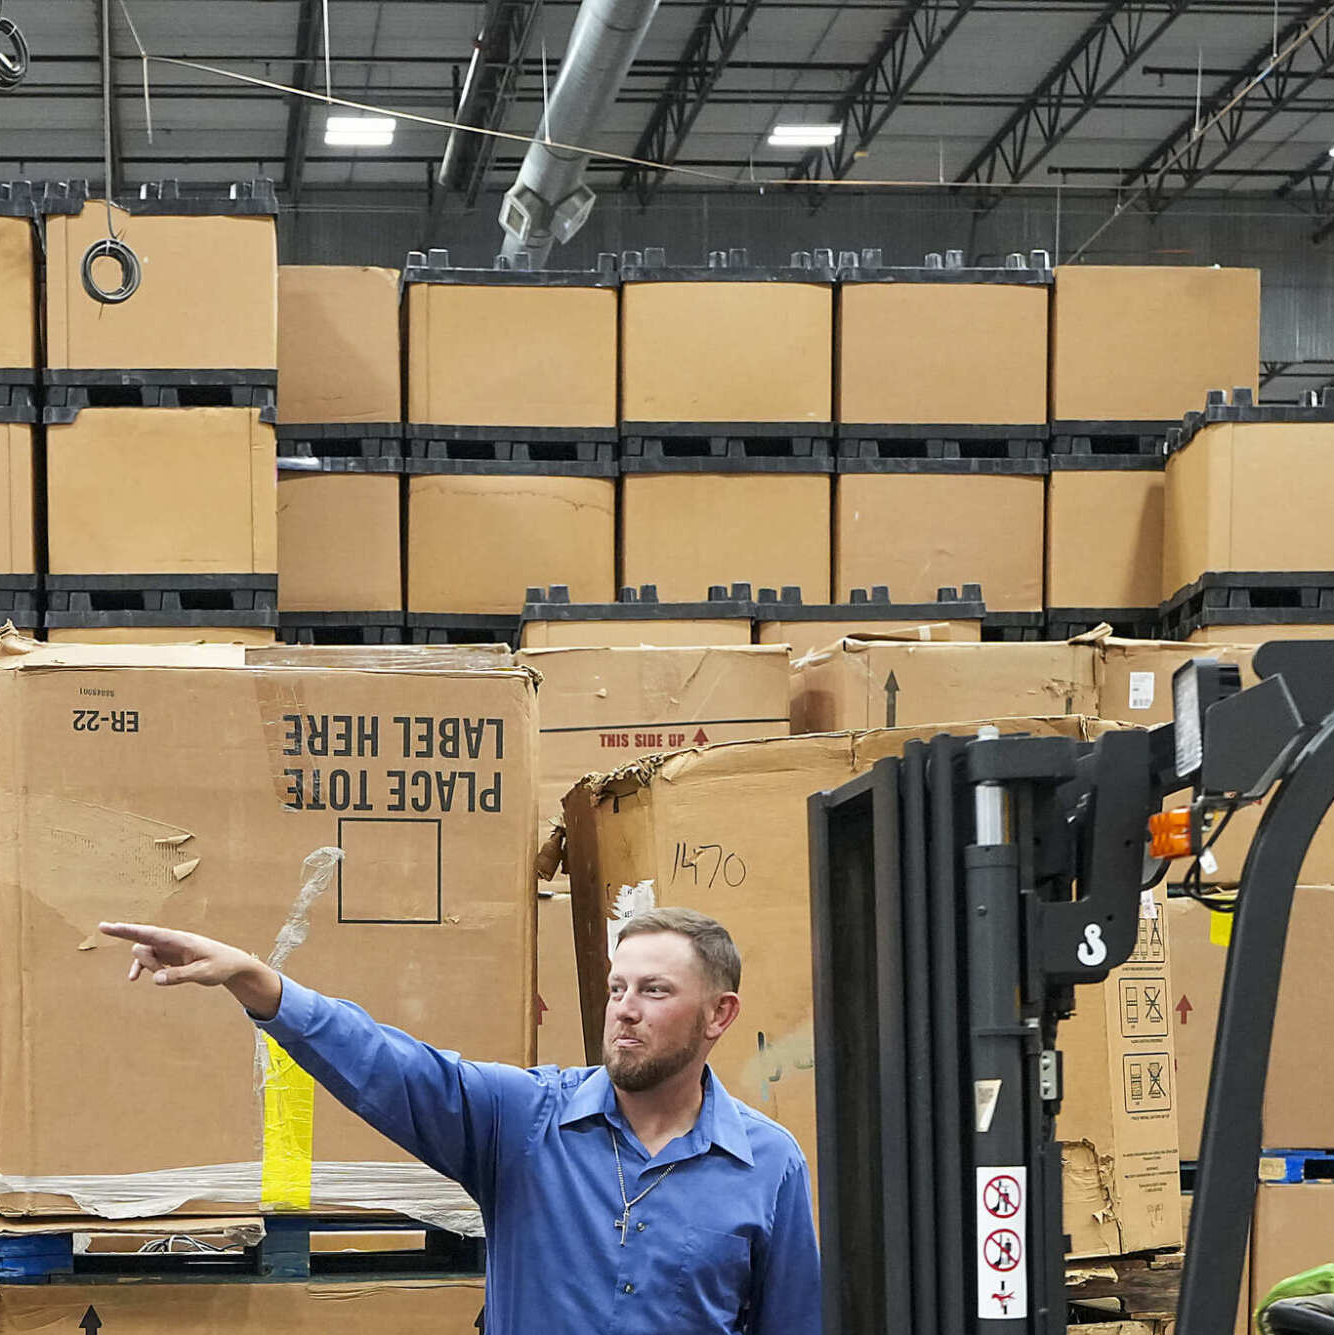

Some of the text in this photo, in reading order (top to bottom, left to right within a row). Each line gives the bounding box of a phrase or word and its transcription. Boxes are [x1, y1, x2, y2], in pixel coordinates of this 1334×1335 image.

[72, 709, 139, 732] ER-22
[282, 714, 504, 760] LABEL HERE
[599, 733, 686, 748] THIS SIDE UP
[283, 768, 502, 813] PLACE TOTE
[670, 842, 747, 889] 1470
